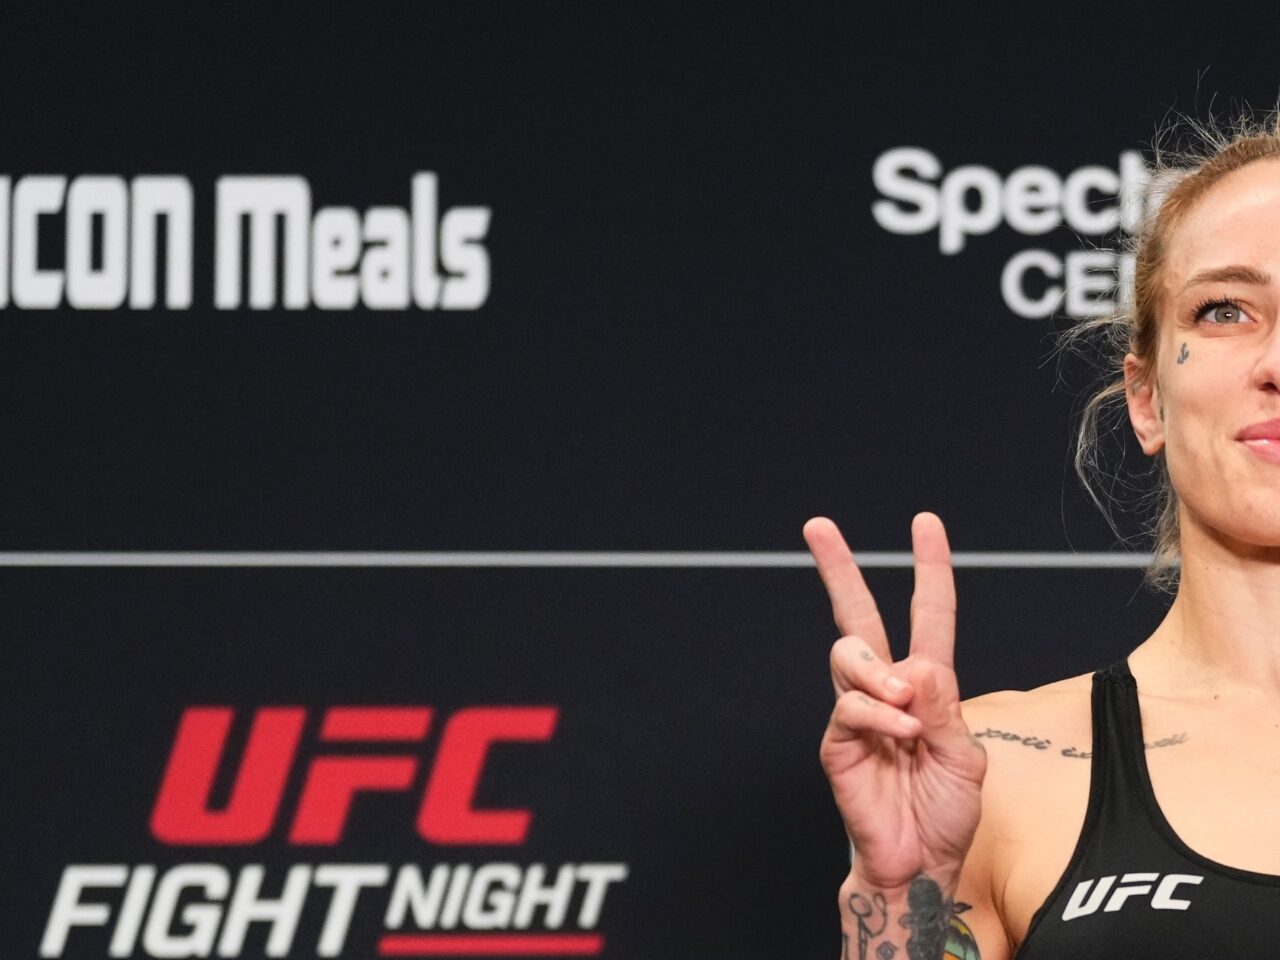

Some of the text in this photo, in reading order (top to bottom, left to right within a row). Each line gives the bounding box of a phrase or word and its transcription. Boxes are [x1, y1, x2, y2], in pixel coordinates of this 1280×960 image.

[214, 171, 492, 310] Meals
[871, 146, 1182, 256] Spect
[149, 706, 559, 846] UFC
[38, 863, 629, 959] FIGHT NIGHT
[1061, 872, 1204, 922] UFC
